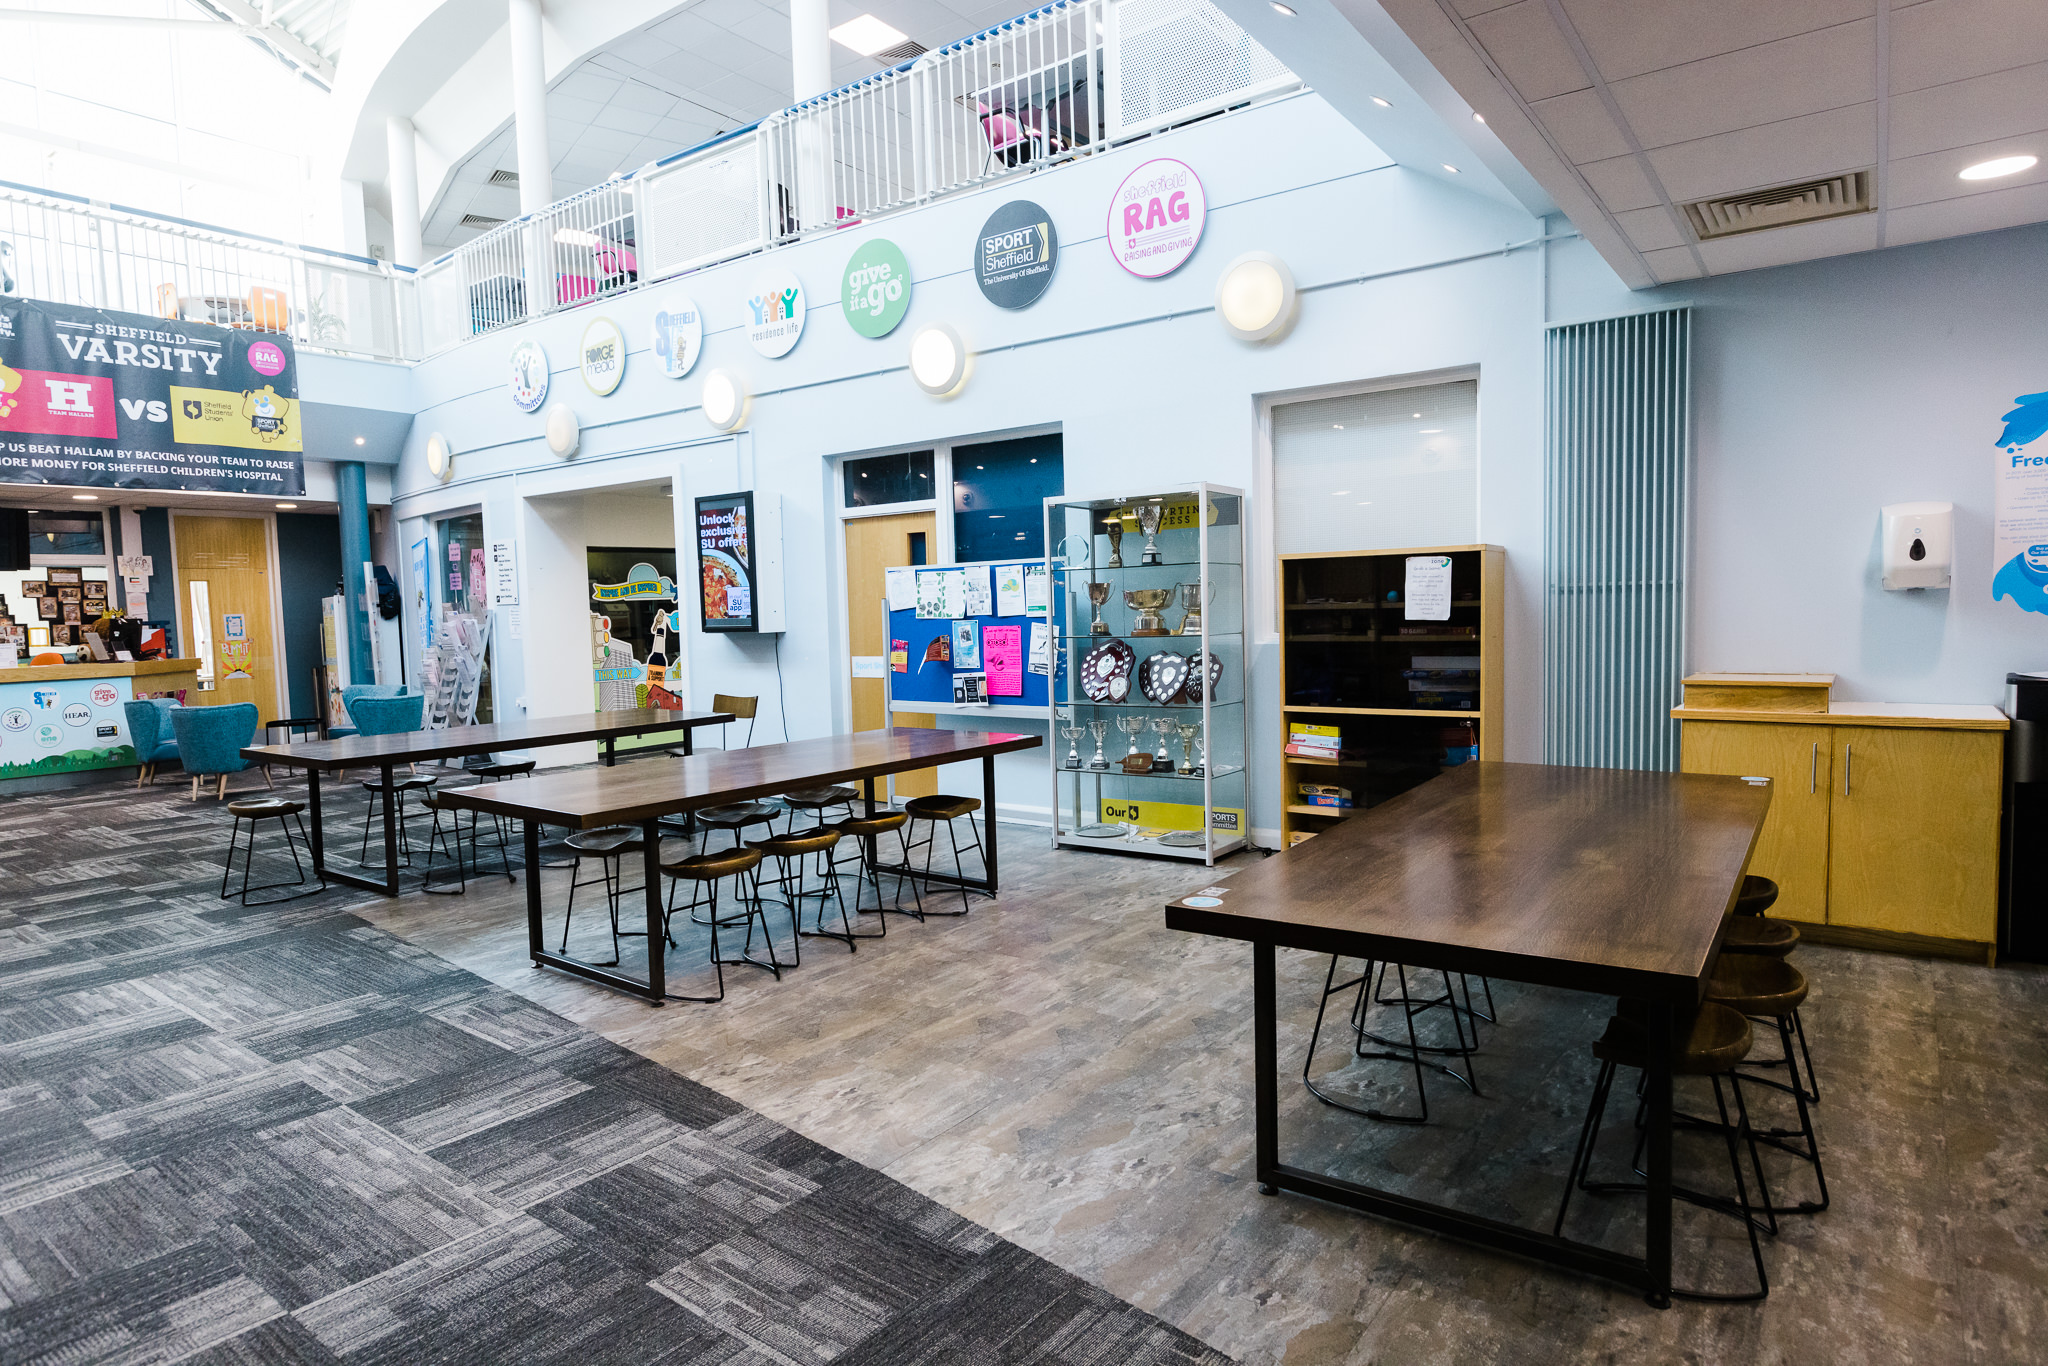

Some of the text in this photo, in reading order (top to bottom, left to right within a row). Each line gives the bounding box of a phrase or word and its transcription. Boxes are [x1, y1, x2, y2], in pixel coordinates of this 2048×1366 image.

[1124, 170, 1186, 202] sheffield
[1124, 191, 1189, 236] RAG
[986, 229, 1032, 254] SPORT
[1124, 236, 1192, 262] RAISING AND GIVING
[986, 248, 1034, 271] Sheffield
[849, 262, 891, 295] give
[994, 272, 1018, 283] University
[850, 296, 860, 311] it
[860, 297, 868, 308] a
[95, 323, 187, 345] SHEFFIELD
[752, 322, 799, 342] residence life
[56, 333, 222, 376] VARSITY
[256, 352, 278, 364] RAG
[586, 344, 614, 364] FORGE
[586, 360, 615, 376] media
[45, 379, 94, 413] H
[204, 401, 232, 410] Sheffield
[8, 443, 26, 453] US
[28, 444, 61, 454] BEAT
[64, 446, 114, 458] HALLAM
[117, 450, 132, 459] BY
[136, 451, 185, 462] BACKING
[187, 454, 220, 464] YOUR
[221, 456, 248, 466] TEAM
[250, 458, 264, 468] TO
[266, 460, 294, 470] RAISE
[32, 459, 79, 470] MONEY
[82, 462, 106, 471] FOR
[108, 463, 168, 474] SHEFFIELD
[170, 466, 234, 478] CHILDREN'S
[235, 470, 284, 482] HOSPITAL
[700, 512, 734, 526] Unlock
[700, 526, 747, 538] exclusive
[702, 538, 748, 549] SU offers
[598, 669, 632, 680] THIS WAY
[1106, 806, 1126, 817] Our
